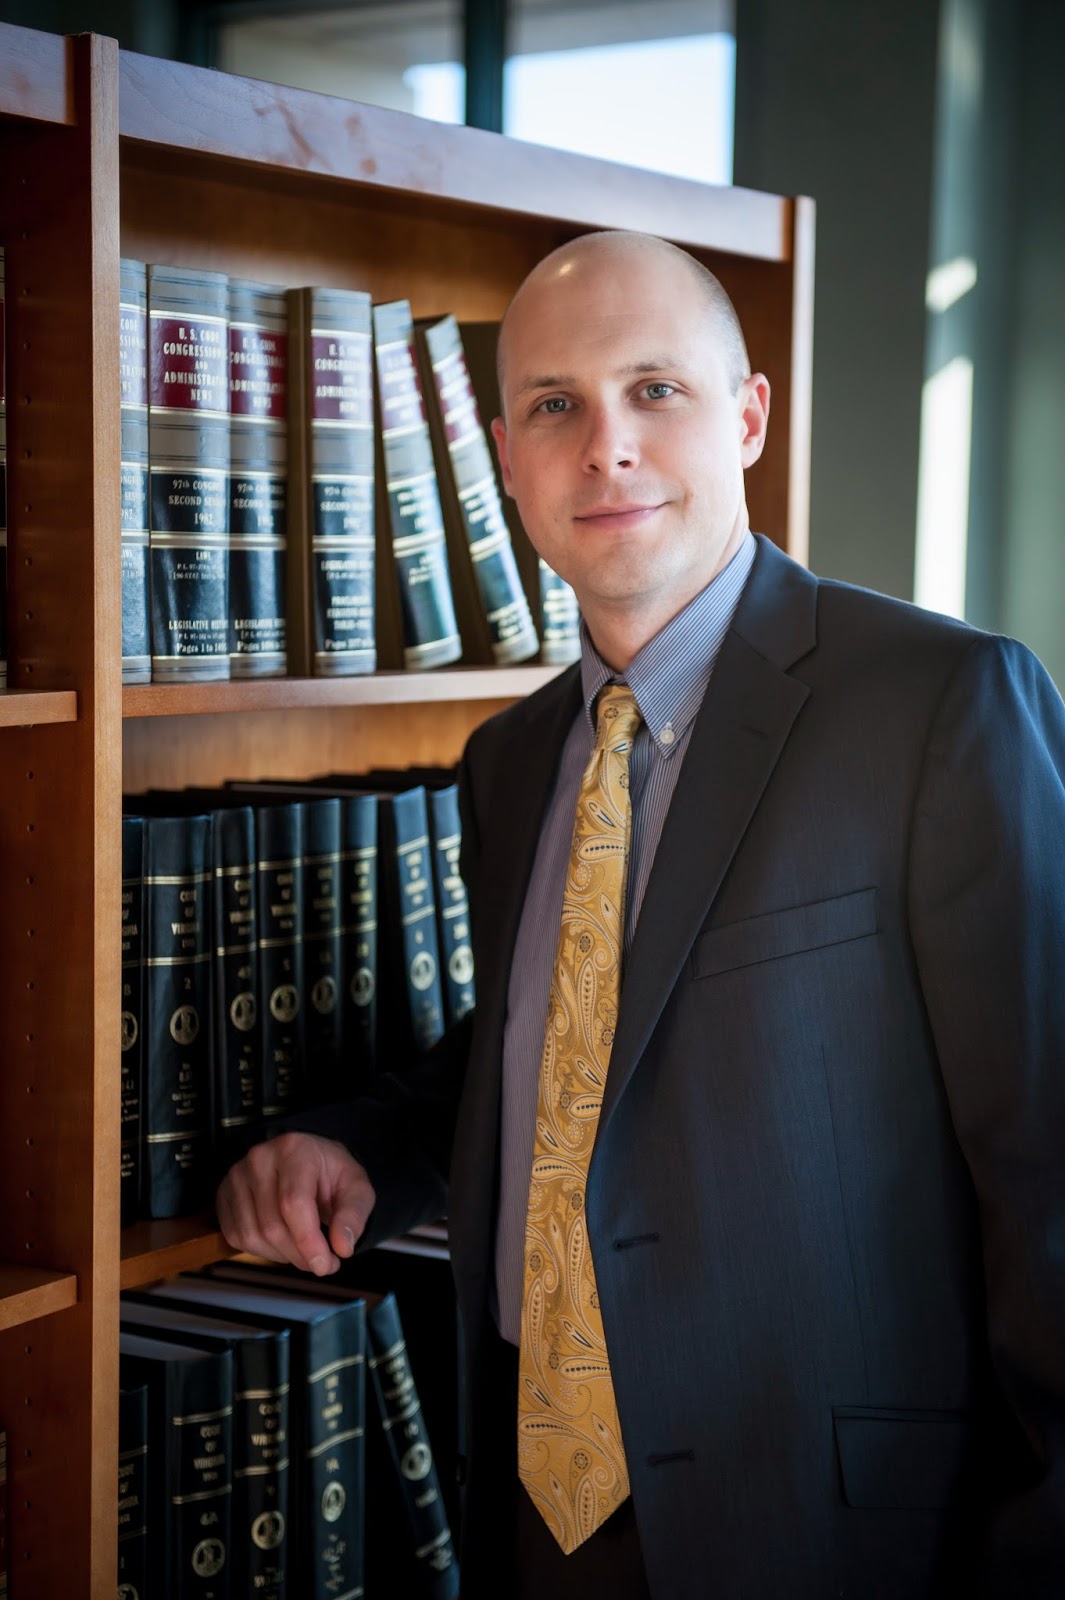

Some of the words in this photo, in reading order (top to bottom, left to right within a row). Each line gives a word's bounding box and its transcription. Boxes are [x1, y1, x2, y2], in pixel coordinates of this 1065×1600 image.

[200, 329, 220, 343] CODE
[195, 360, 209, 371] AND
[190, 388, 213, 401] NEWS
[172, 479, 190, 489] 97th
[168, 495, 202, 506] SECOND
[194, 512, 213, 525] 1982
[168, 619, 209, 630] LEGISLATIVE
[176, 642, 199, 654] Pages
